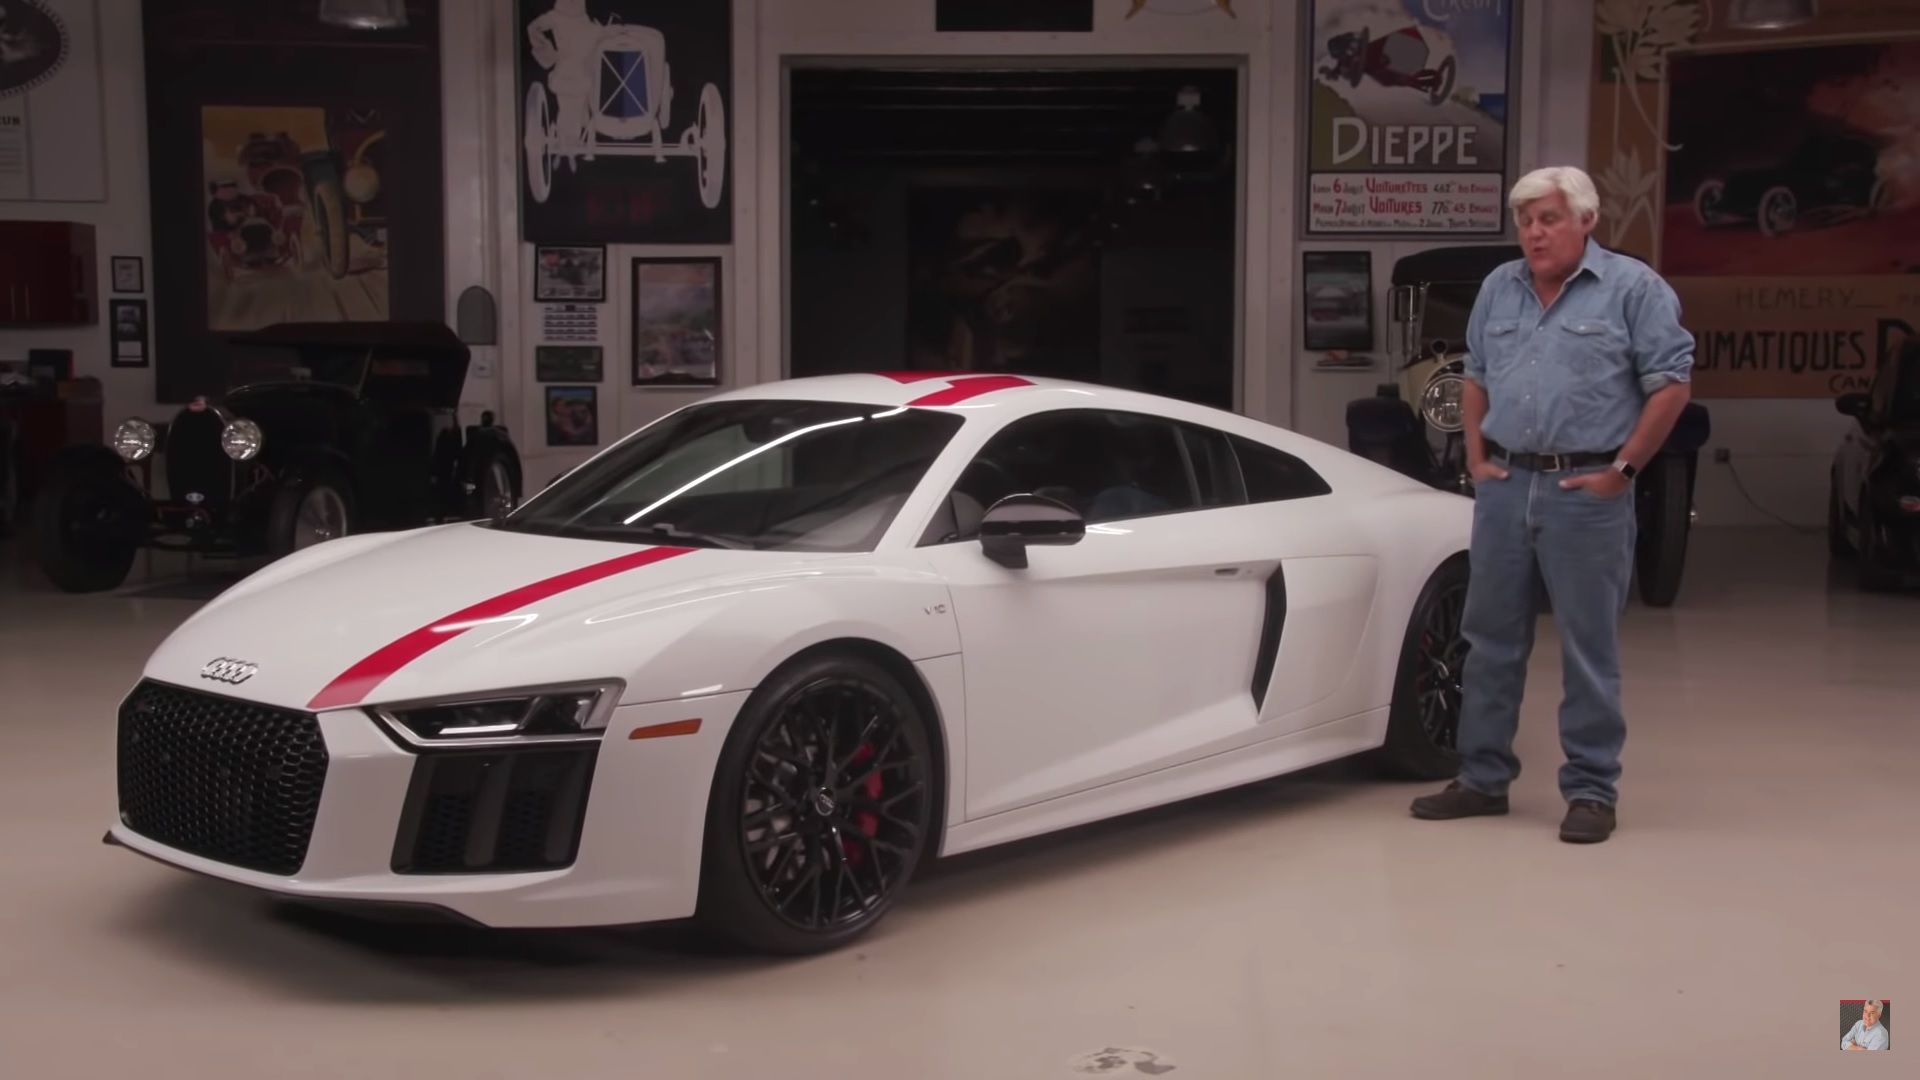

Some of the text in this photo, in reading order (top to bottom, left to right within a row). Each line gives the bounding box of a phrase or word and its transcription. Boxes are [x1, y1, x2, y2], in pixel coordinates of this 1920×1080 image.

[1331, 116, 1479, 166] DIEPPE
[1333, 177, 1342, 194] 6
[1365, 176, 1428, 194] VOITURETTES
[1334, 198, 1343, 217] 7
[1369, 196, 1422, 215] VOITURES
[1736, 286, 1855, 310] HEMERY
[1694, 331, 1867, 374] UMATIQUES
